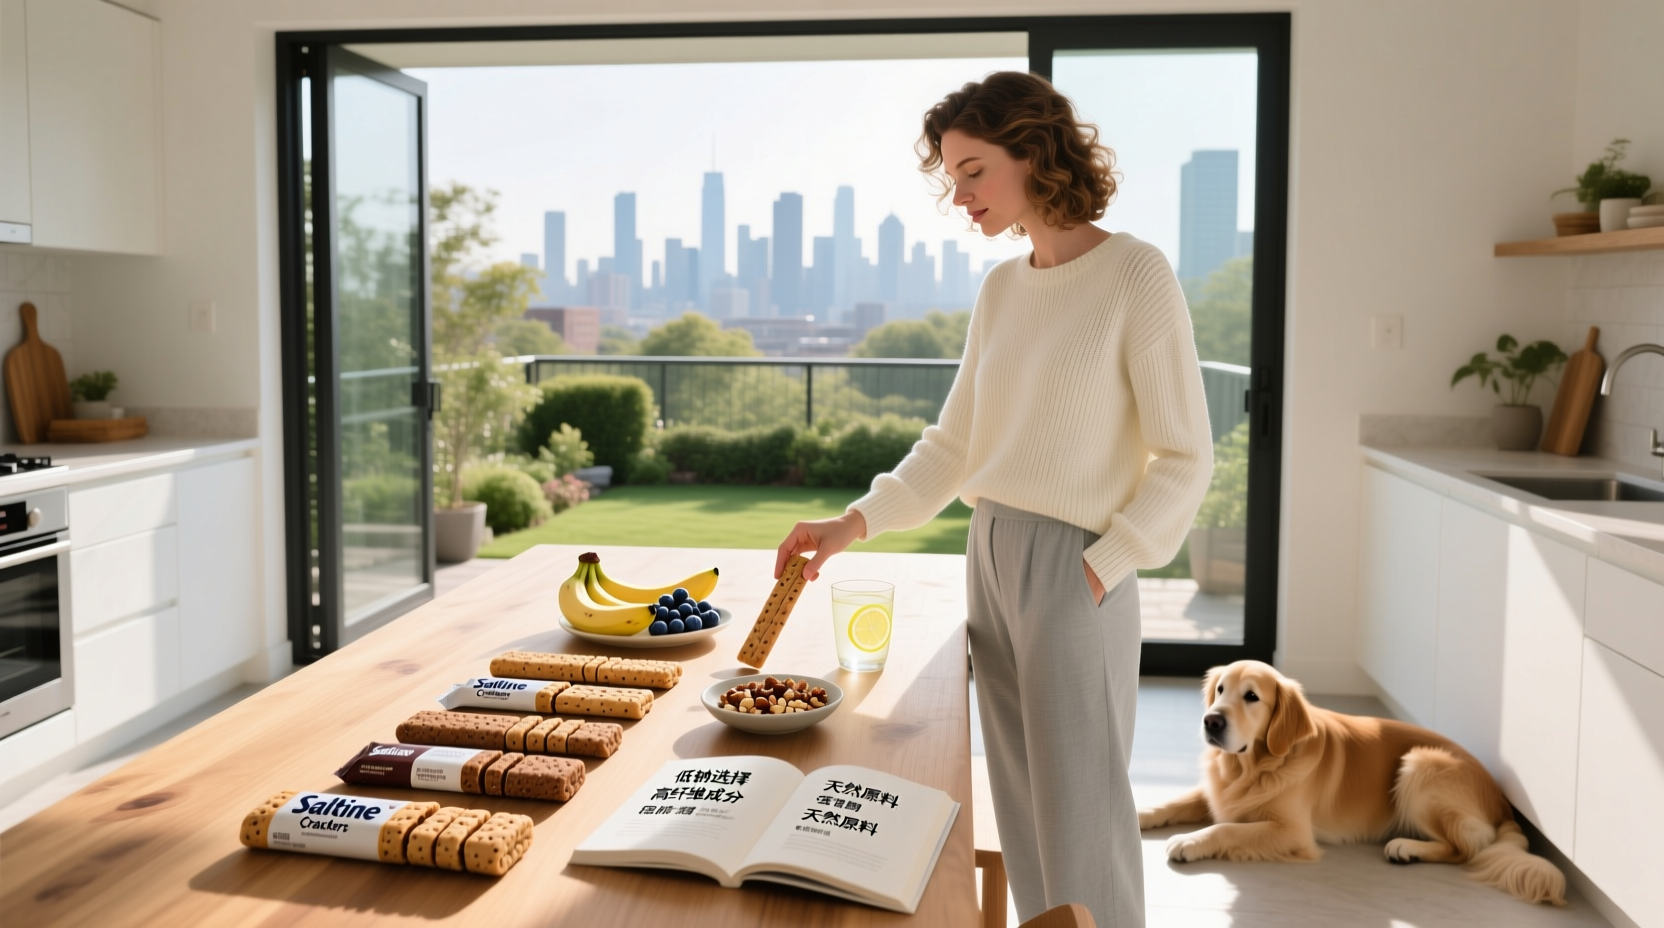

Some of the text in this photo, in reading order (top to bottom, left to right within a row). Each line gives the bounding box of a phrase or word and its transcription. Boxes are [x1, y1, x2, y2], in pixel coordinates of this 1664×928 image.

[291, 795, 381, 820] Saltine
[823, 779, 899, 808] 天然原料
[801, 808, 878, 836] 天然原料
